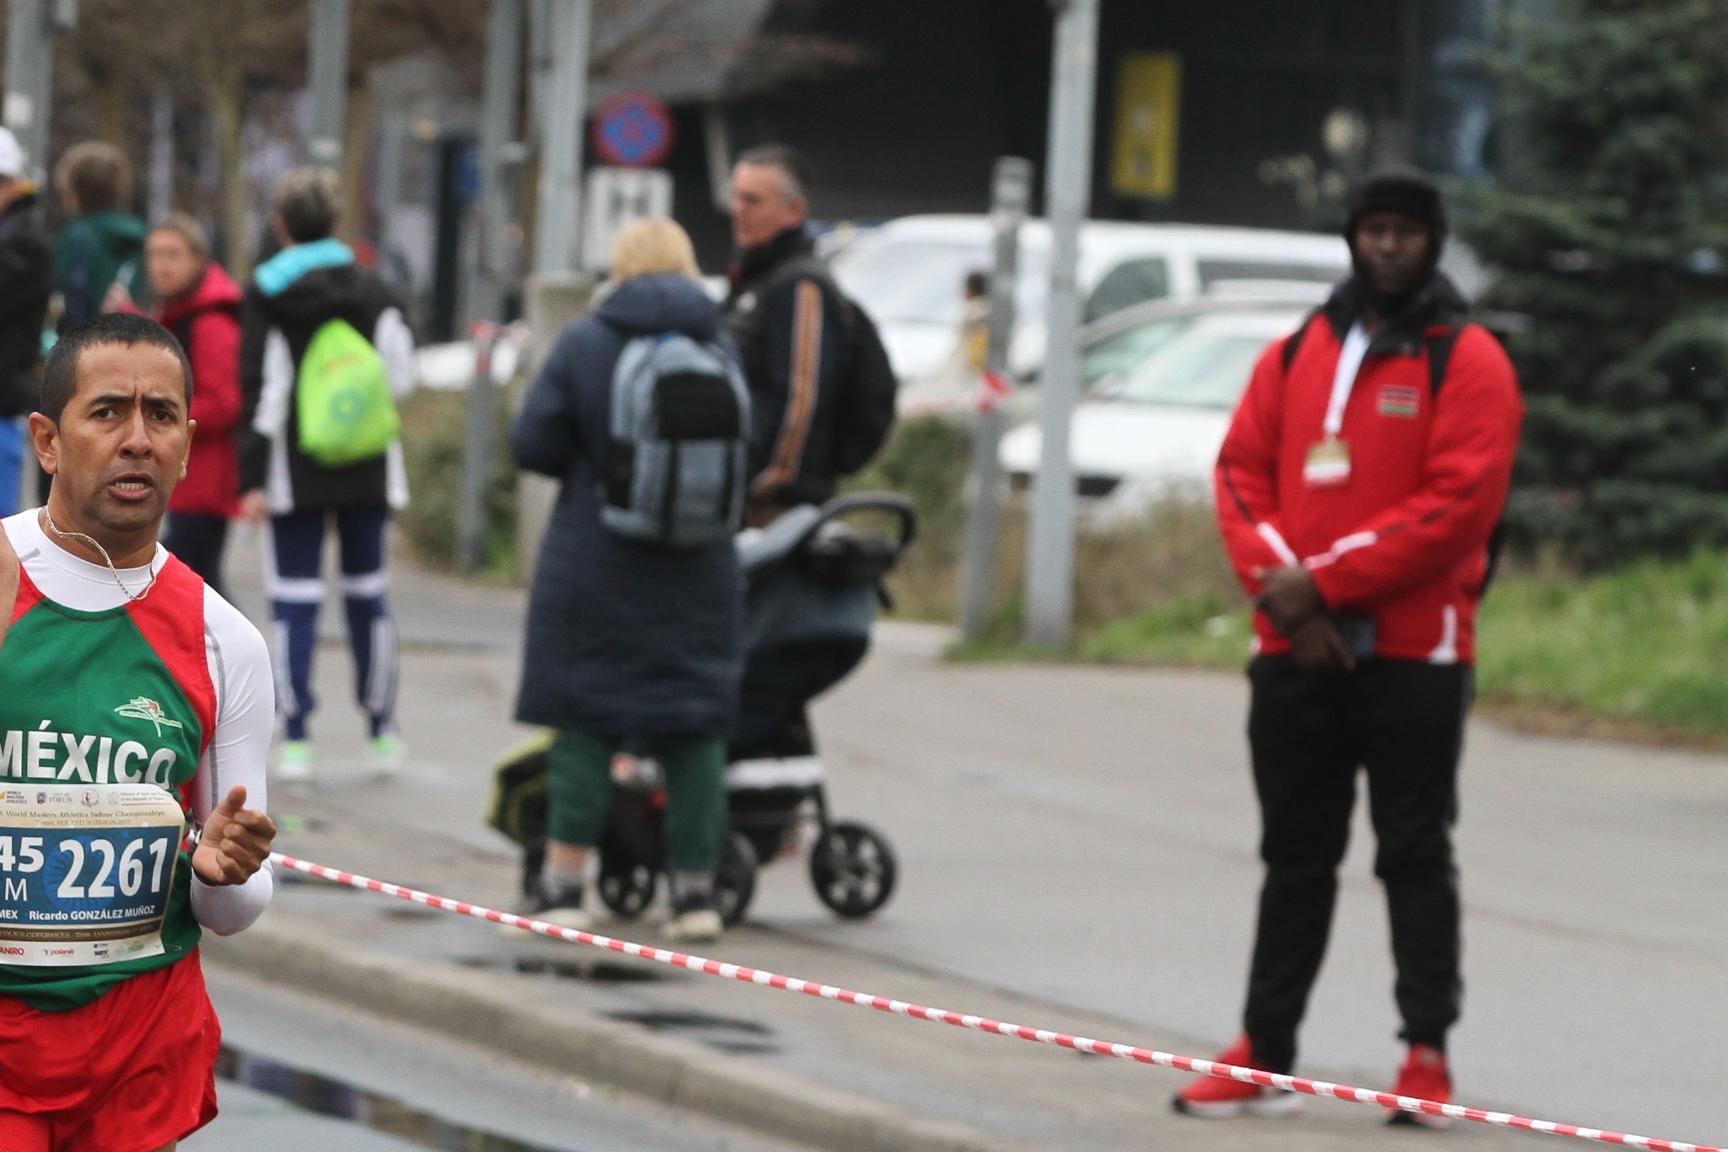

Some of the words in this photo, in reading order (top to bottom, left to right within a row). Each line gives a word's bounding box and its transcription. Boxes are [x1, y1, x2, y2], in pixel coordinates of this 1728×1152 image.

[57, 838, 169, 899] 2261
[4, 877, 28, 901] M
[29, 910, 68, 921] Ricardo
[71, 908, 123, 920] GONZÁLEZ
[124, 905, 156, 918] MUÑOZ
[0, 946, 25, 956] ANIRO
